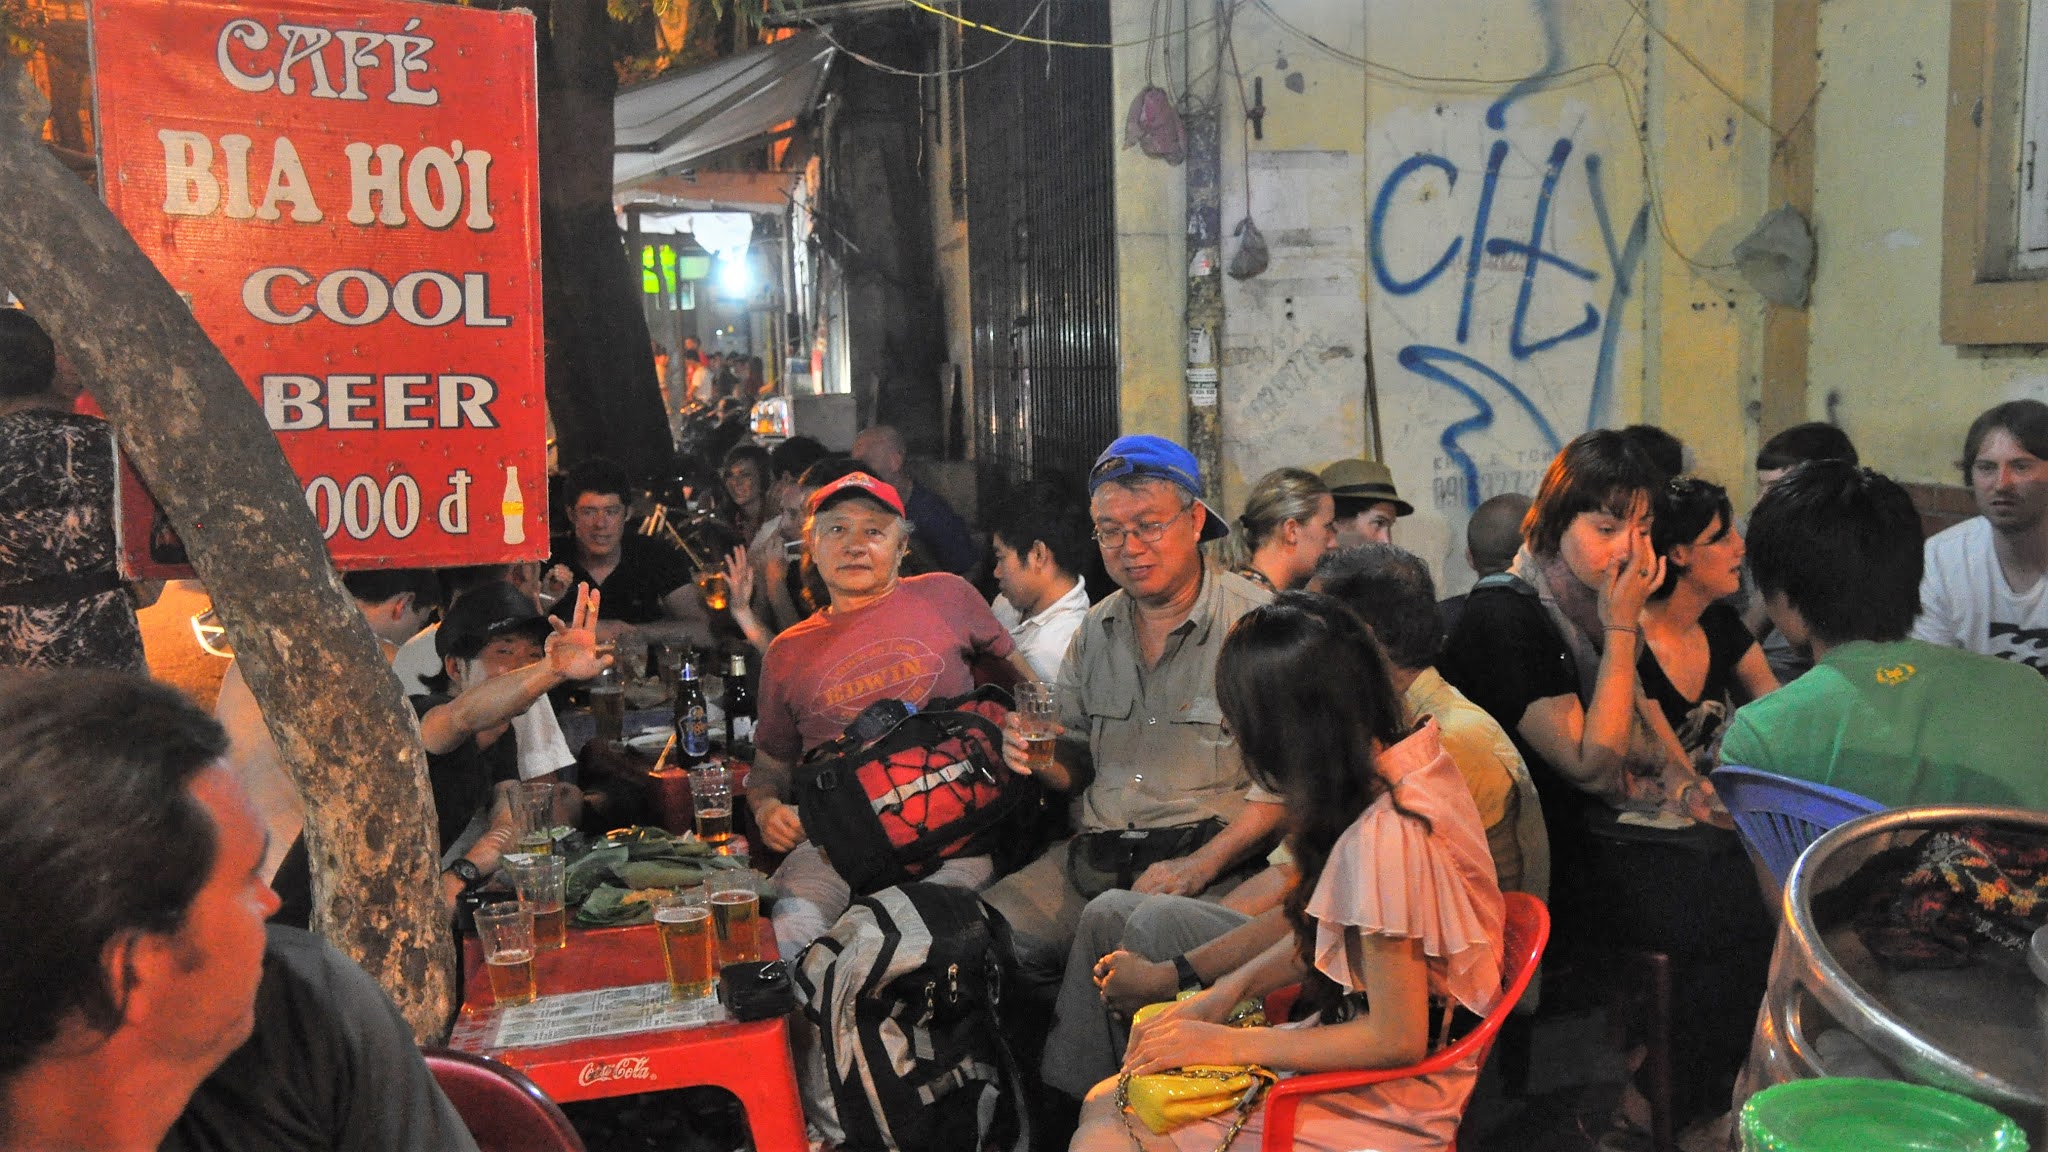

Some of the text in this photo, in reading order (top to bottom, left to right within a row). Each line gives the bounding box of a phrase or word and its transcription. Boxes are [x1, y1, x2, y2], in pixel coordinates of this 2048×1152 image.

[217, 19, 438, 106] CAFÉ
[158, 129, 322, 223] BIA
[242, 267, 512, 327] COOL
[262, 375, 499, 430] BEER
